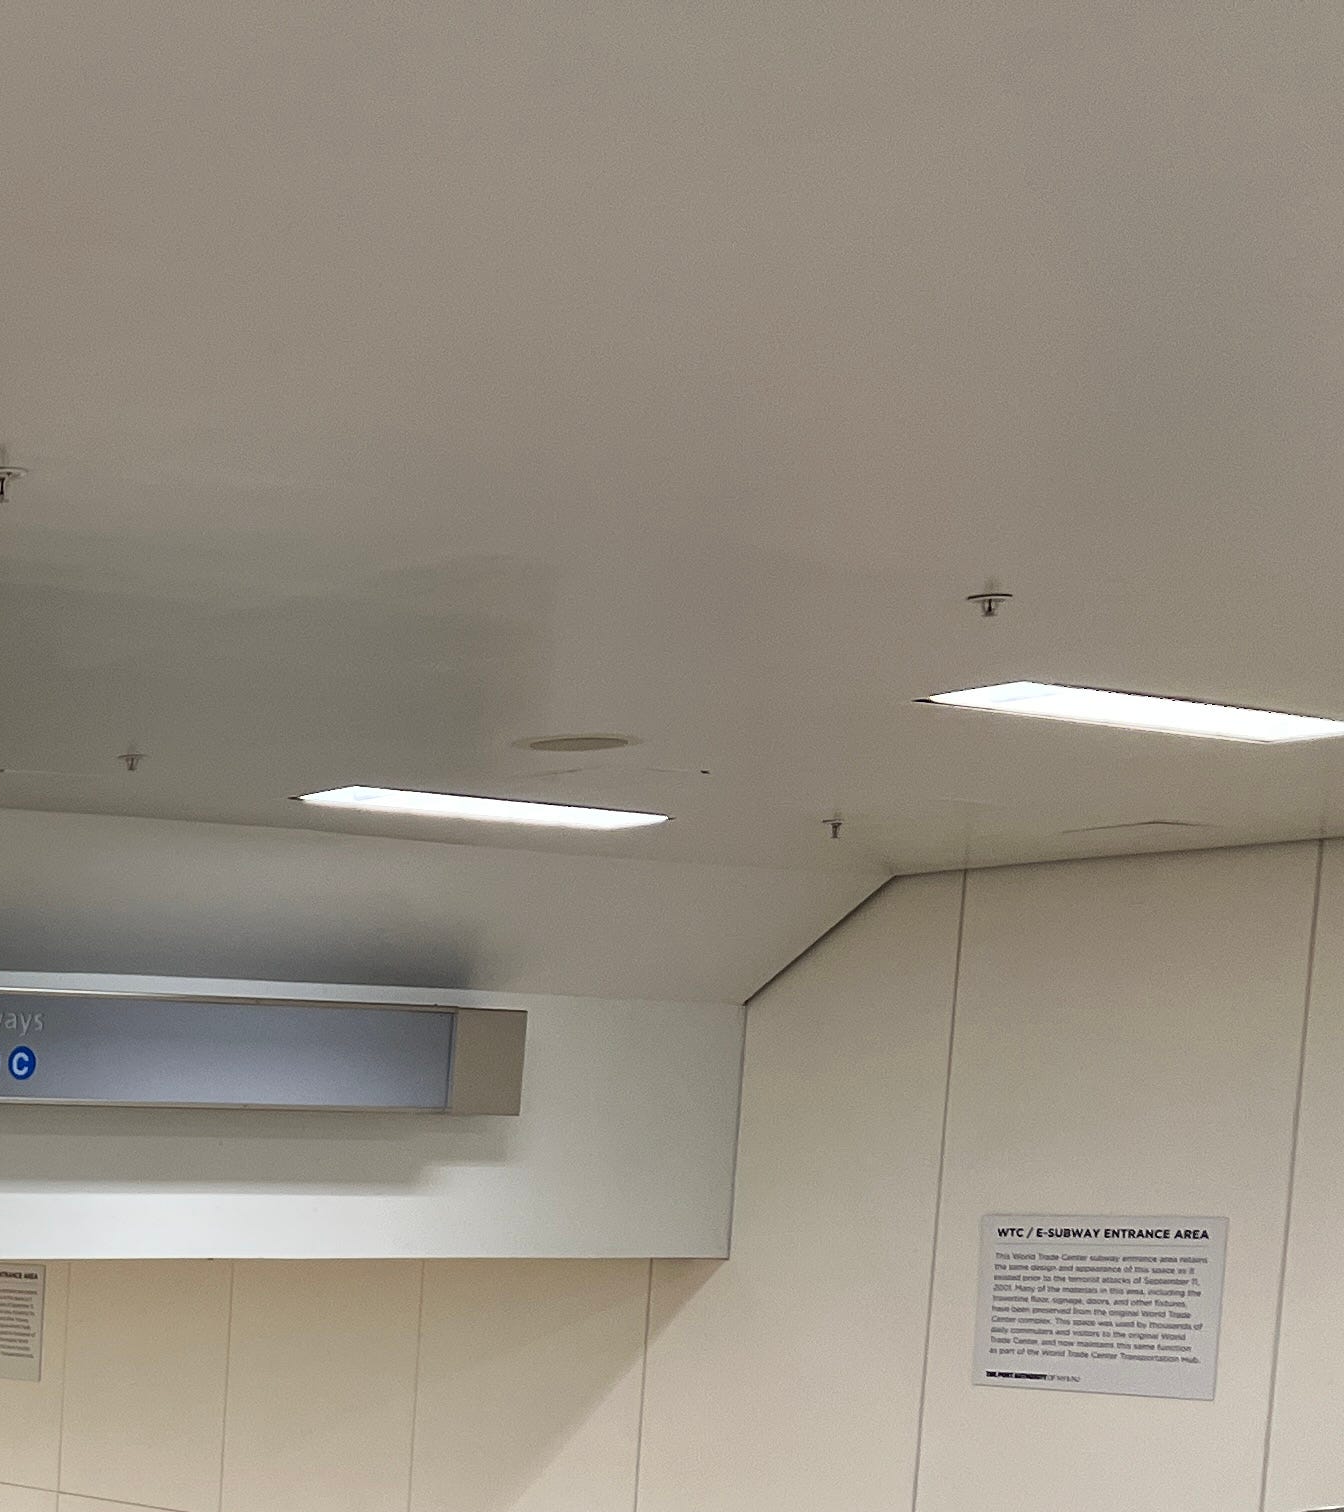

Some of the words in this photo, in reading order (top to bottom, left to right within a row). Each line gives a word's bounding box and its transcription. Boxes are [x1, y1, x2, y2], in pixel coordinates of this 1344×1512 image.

[12, 1052, 30, 1076] C
[997, 1228, 1025, 1238] WTC
[1036, 1228, 1100, 1238] E-SUBWAY
[1104, 1228, 1171, 1239] ENTRANCE
[1174, 1229, 1210, 1240] AREA
